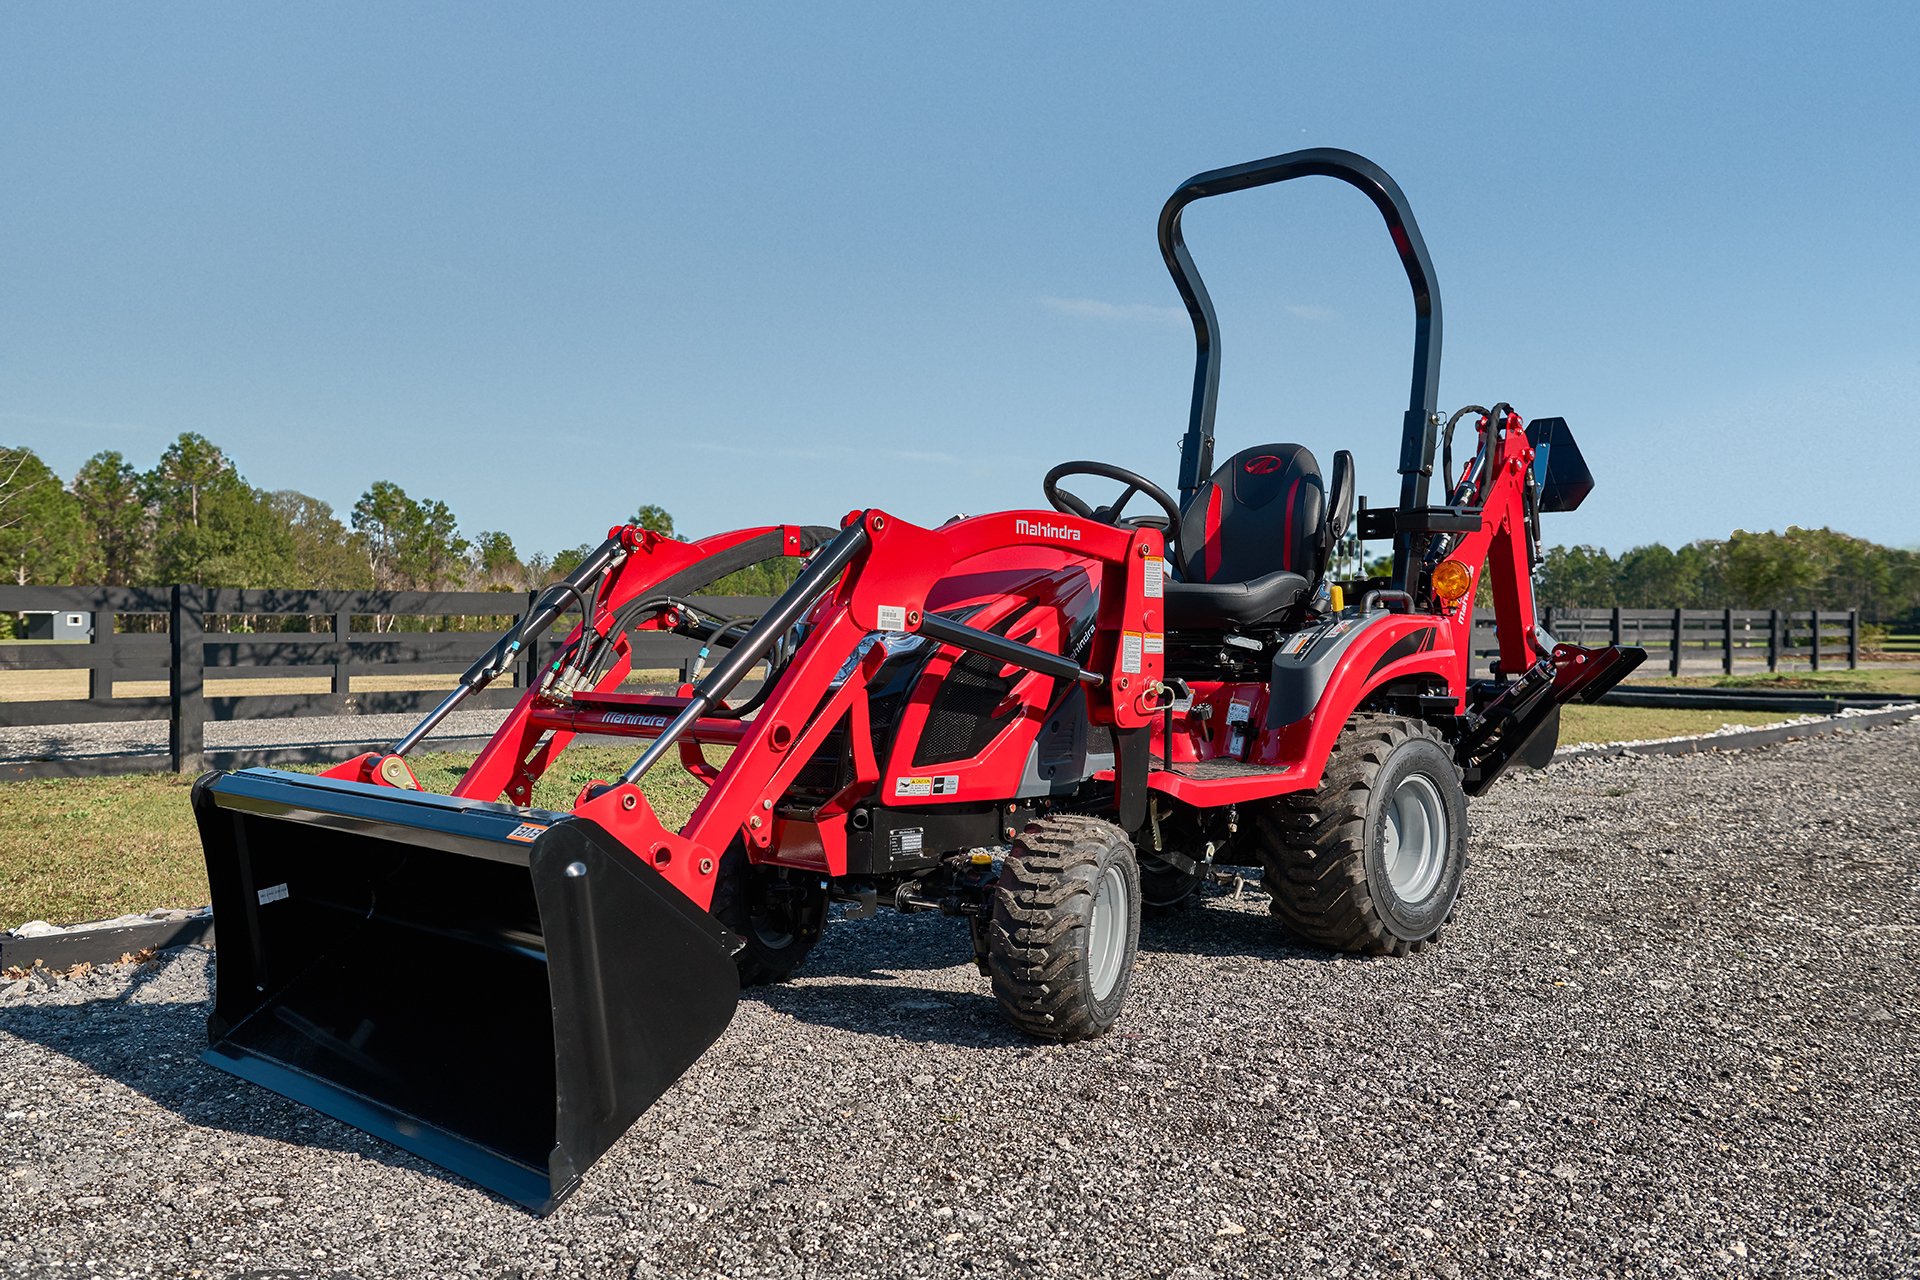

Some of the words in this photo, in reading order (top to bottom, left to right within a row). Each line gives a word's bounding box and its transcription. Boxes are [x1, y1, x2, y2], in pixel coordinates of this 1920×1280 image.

[1016, 519, 1081, 541] Mahindra
[1070, 624, 1096, 660] ahindra
[601, 711, 668, 728] Mahindra
